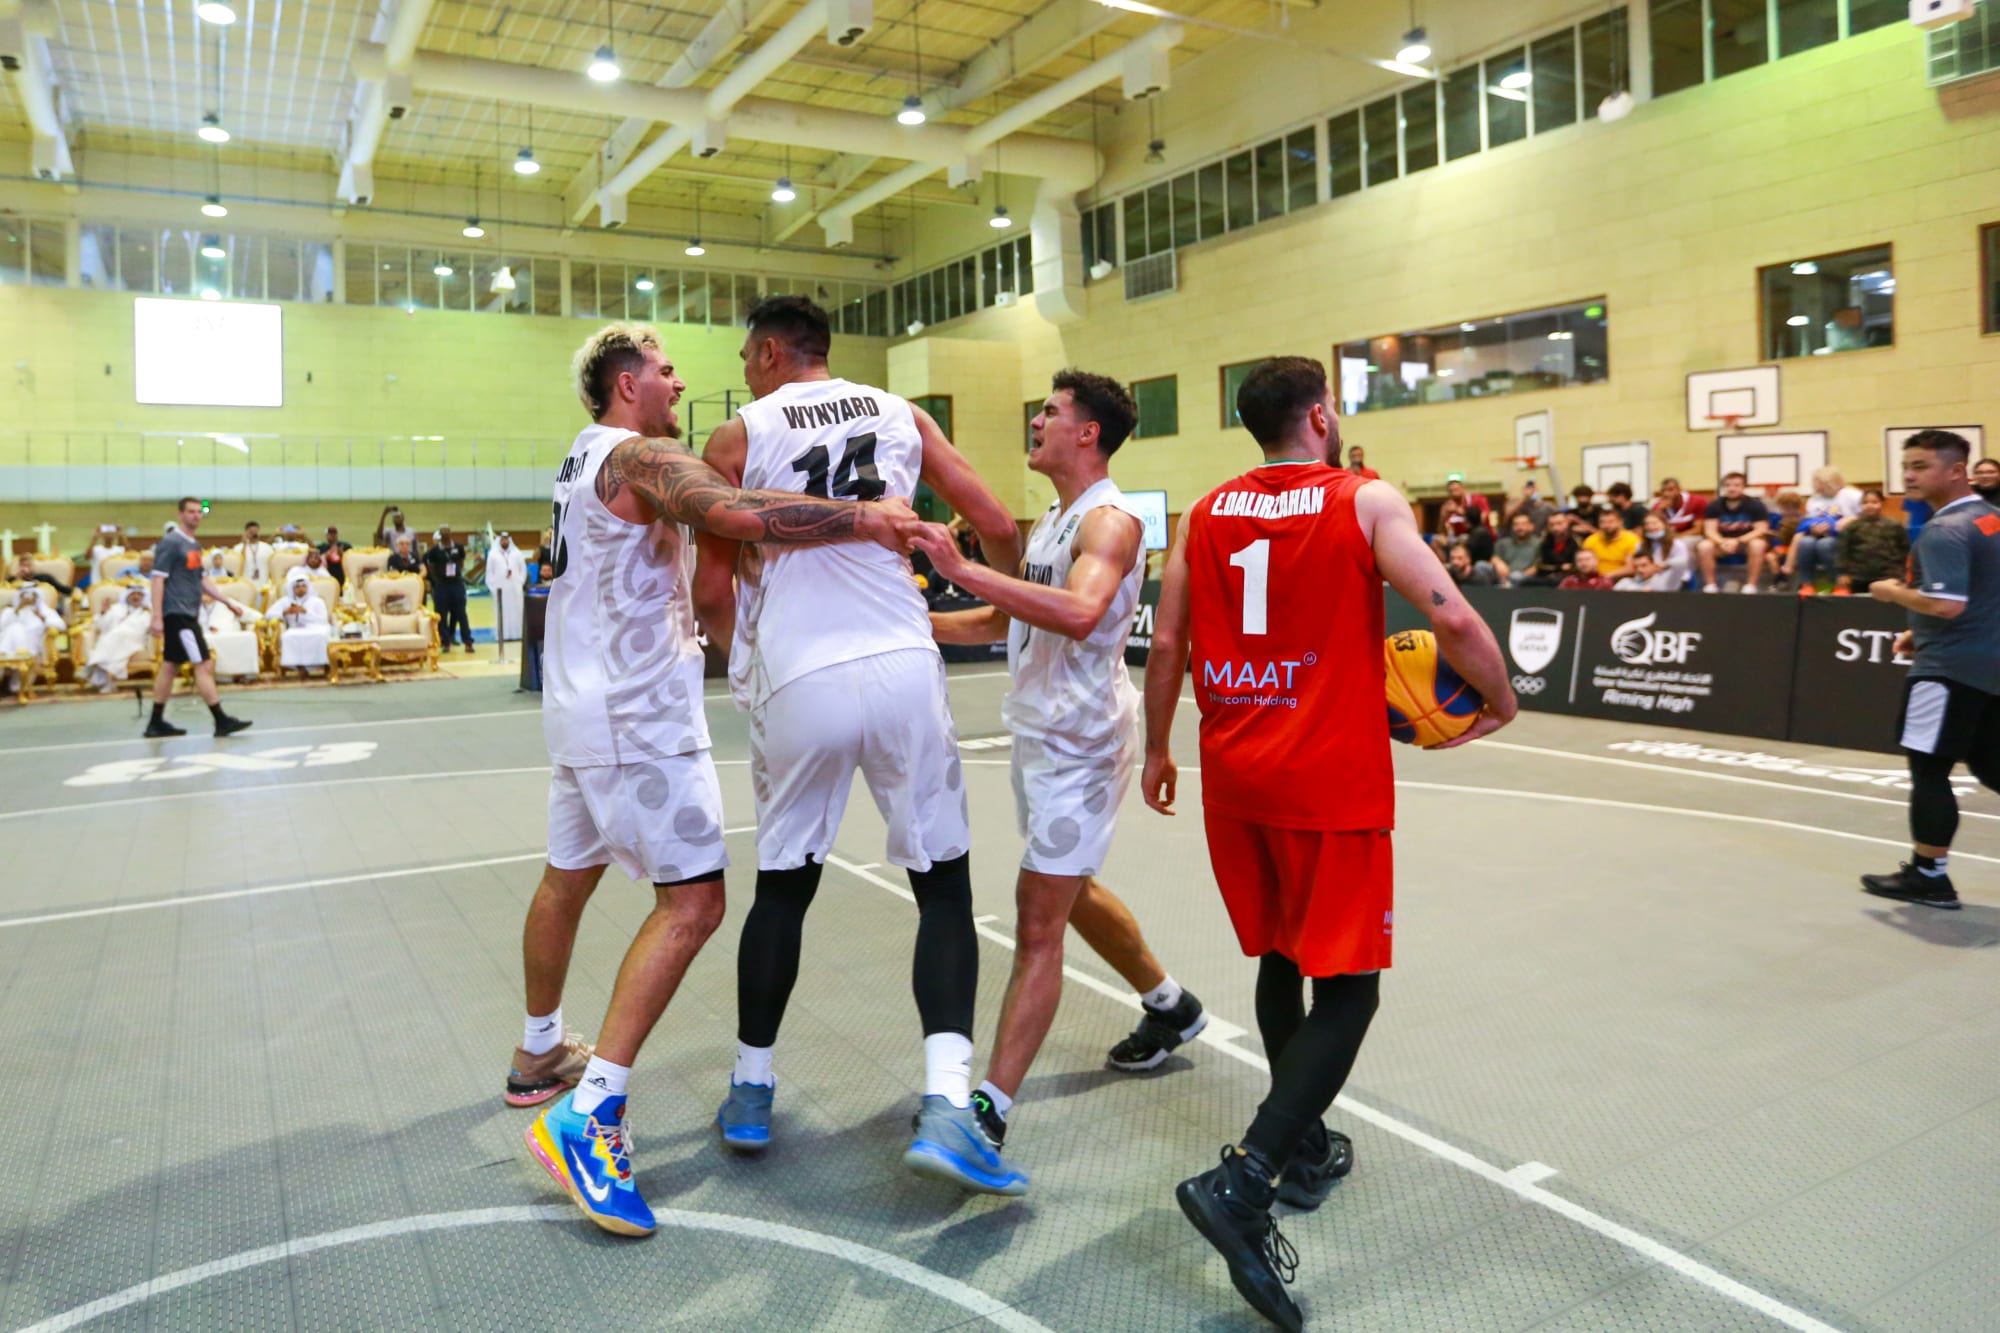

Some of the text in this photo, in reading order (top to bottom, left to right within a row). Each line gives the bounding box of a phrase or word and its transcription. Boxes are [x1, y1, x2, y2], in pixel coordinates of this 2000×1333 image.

[781, 396, 880, 430] WYNYARD
[791, 431, 887, 502] 14
[1229, 539, 1271, 635] 1
[1203, 660, 1301, 689] MAAT
